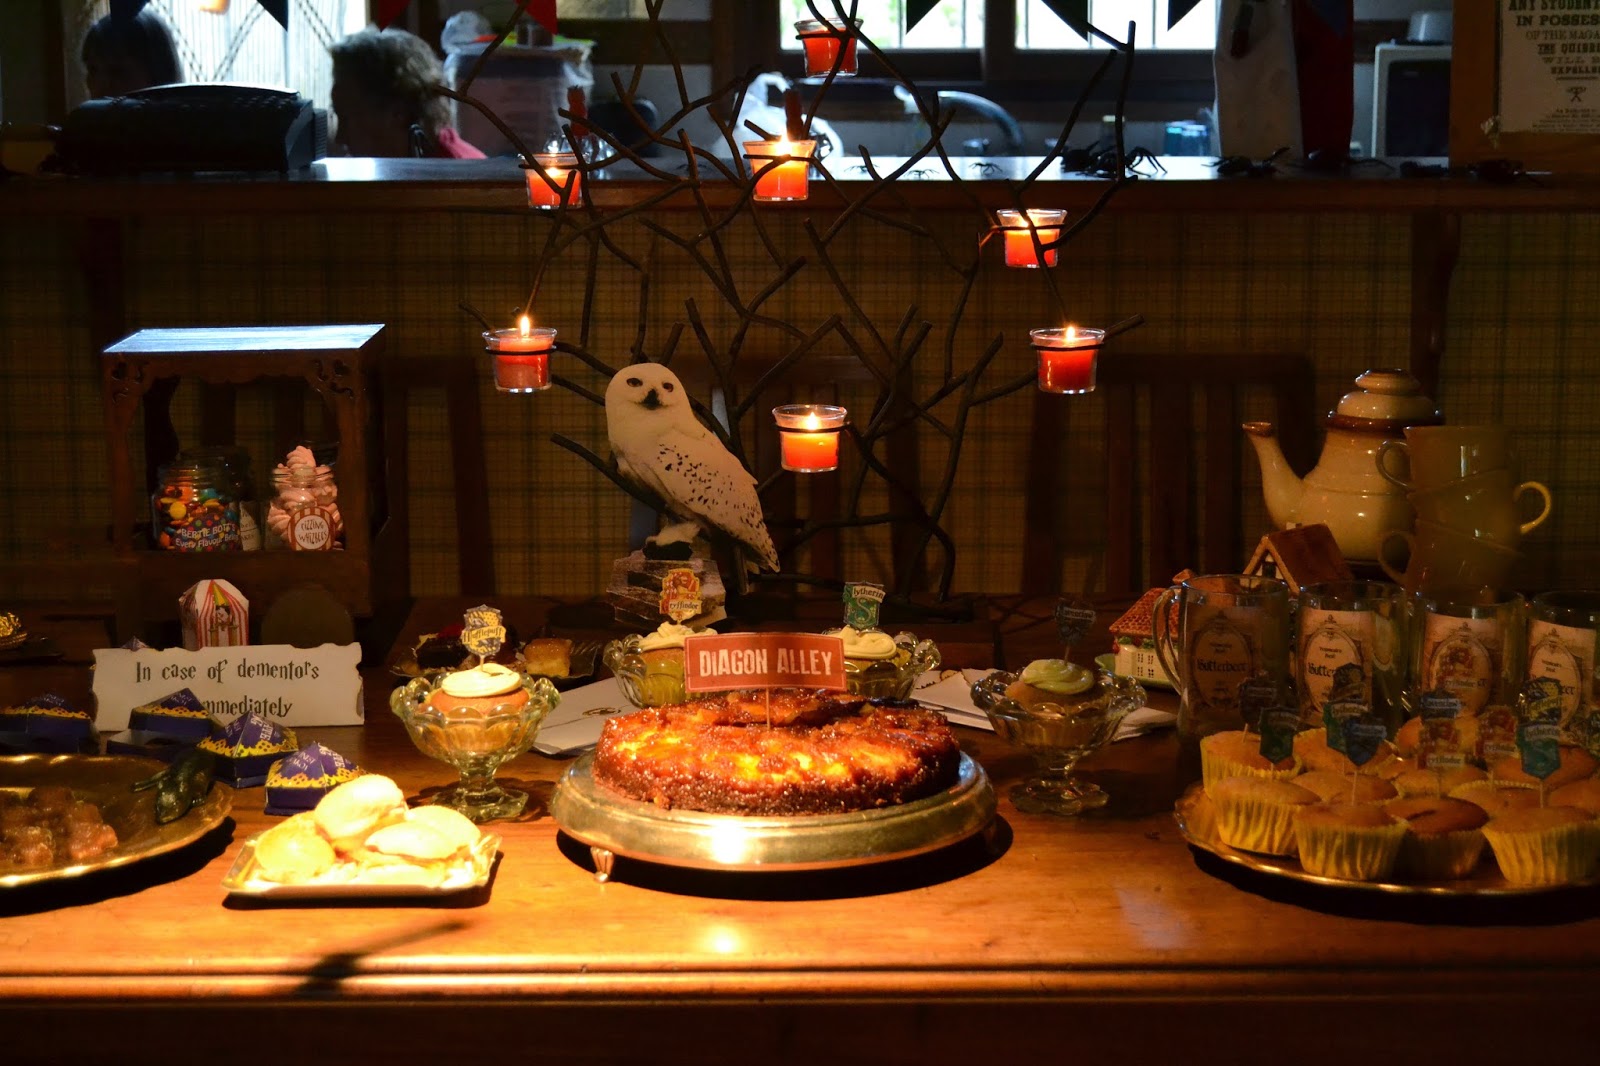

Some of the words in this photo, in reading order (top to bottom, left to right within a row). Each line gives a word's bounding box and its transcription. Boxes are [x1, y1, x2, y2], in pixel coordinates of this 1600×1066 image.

[1509, 0, 1535, 11] ANY
[1516, 15, 1533, 26] IN
[1542, 30, 1566, 40] THE
[175, 538, 196, 549] Every
[777, 648, 832, 676] ALLEY
[136, 661, 151, 683] In
[162, 663, 197, 680] case
[207, 658, 228, 683] of
[237, 658, 319, 681] dementors
